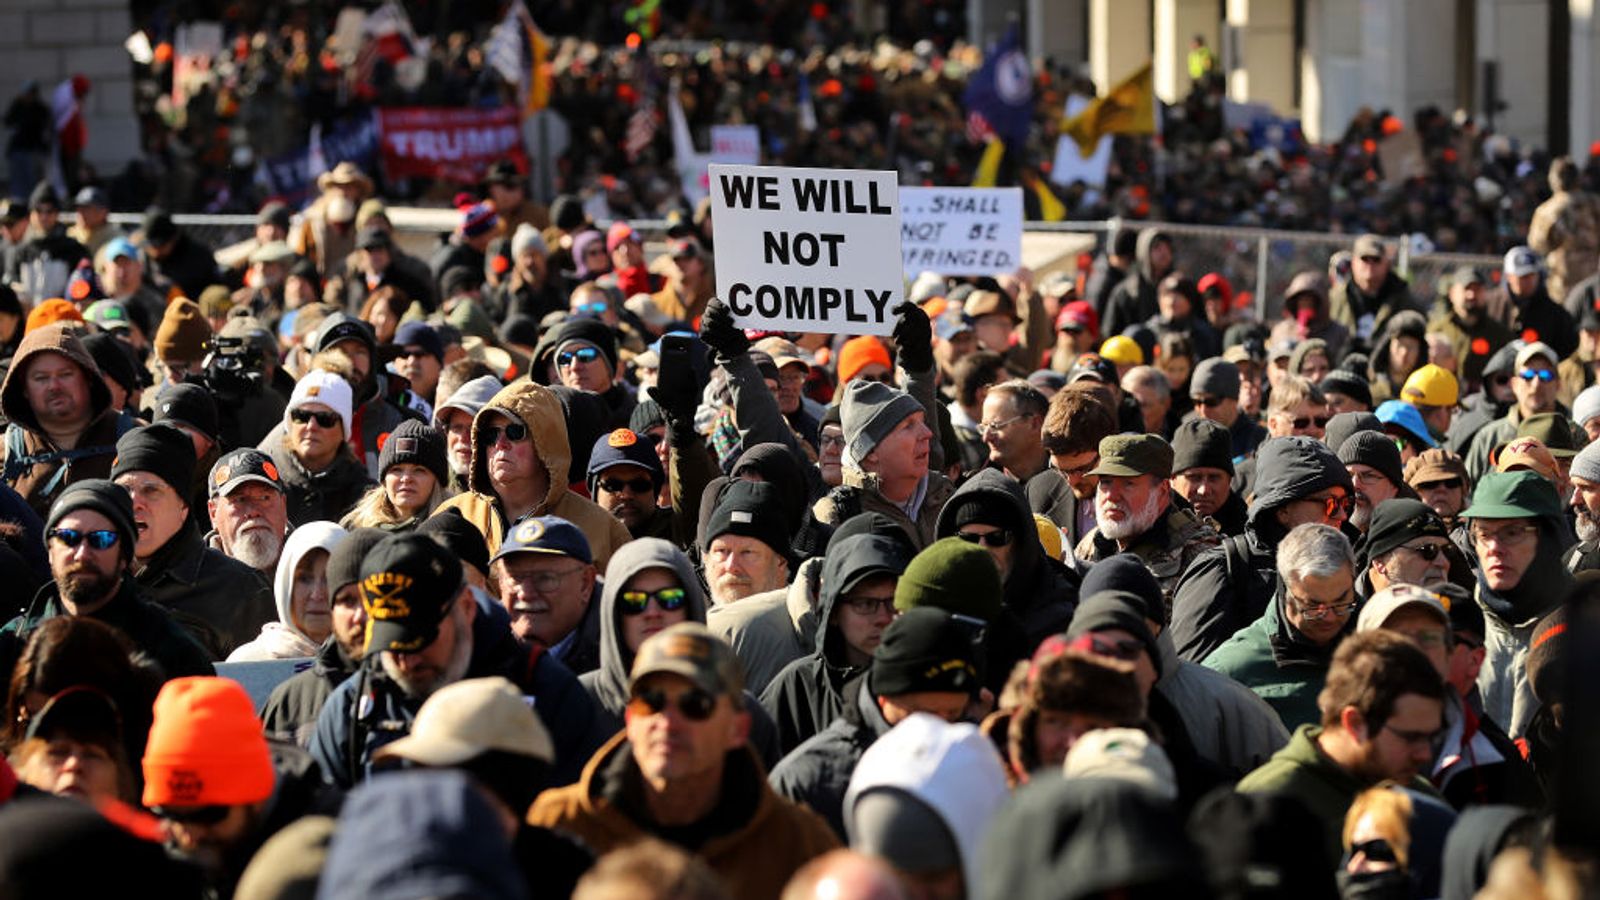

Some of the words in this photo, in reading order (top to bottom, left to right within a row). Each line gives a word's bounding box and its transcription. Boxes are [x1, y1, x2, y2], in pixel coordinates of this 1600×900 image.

[388, 126, 516, 160] TRUMP
[719, 174, 781, 211] WE
[791, 177, 892, 215] WILL
[901, 222, 947, 240] NOT
[967, 223, 999, 240] BE
[763, 231, 845, 267] NOT
[902, 248, 1014, 268] FRINGED.
[728, 282, 892, 323] COMPLY
